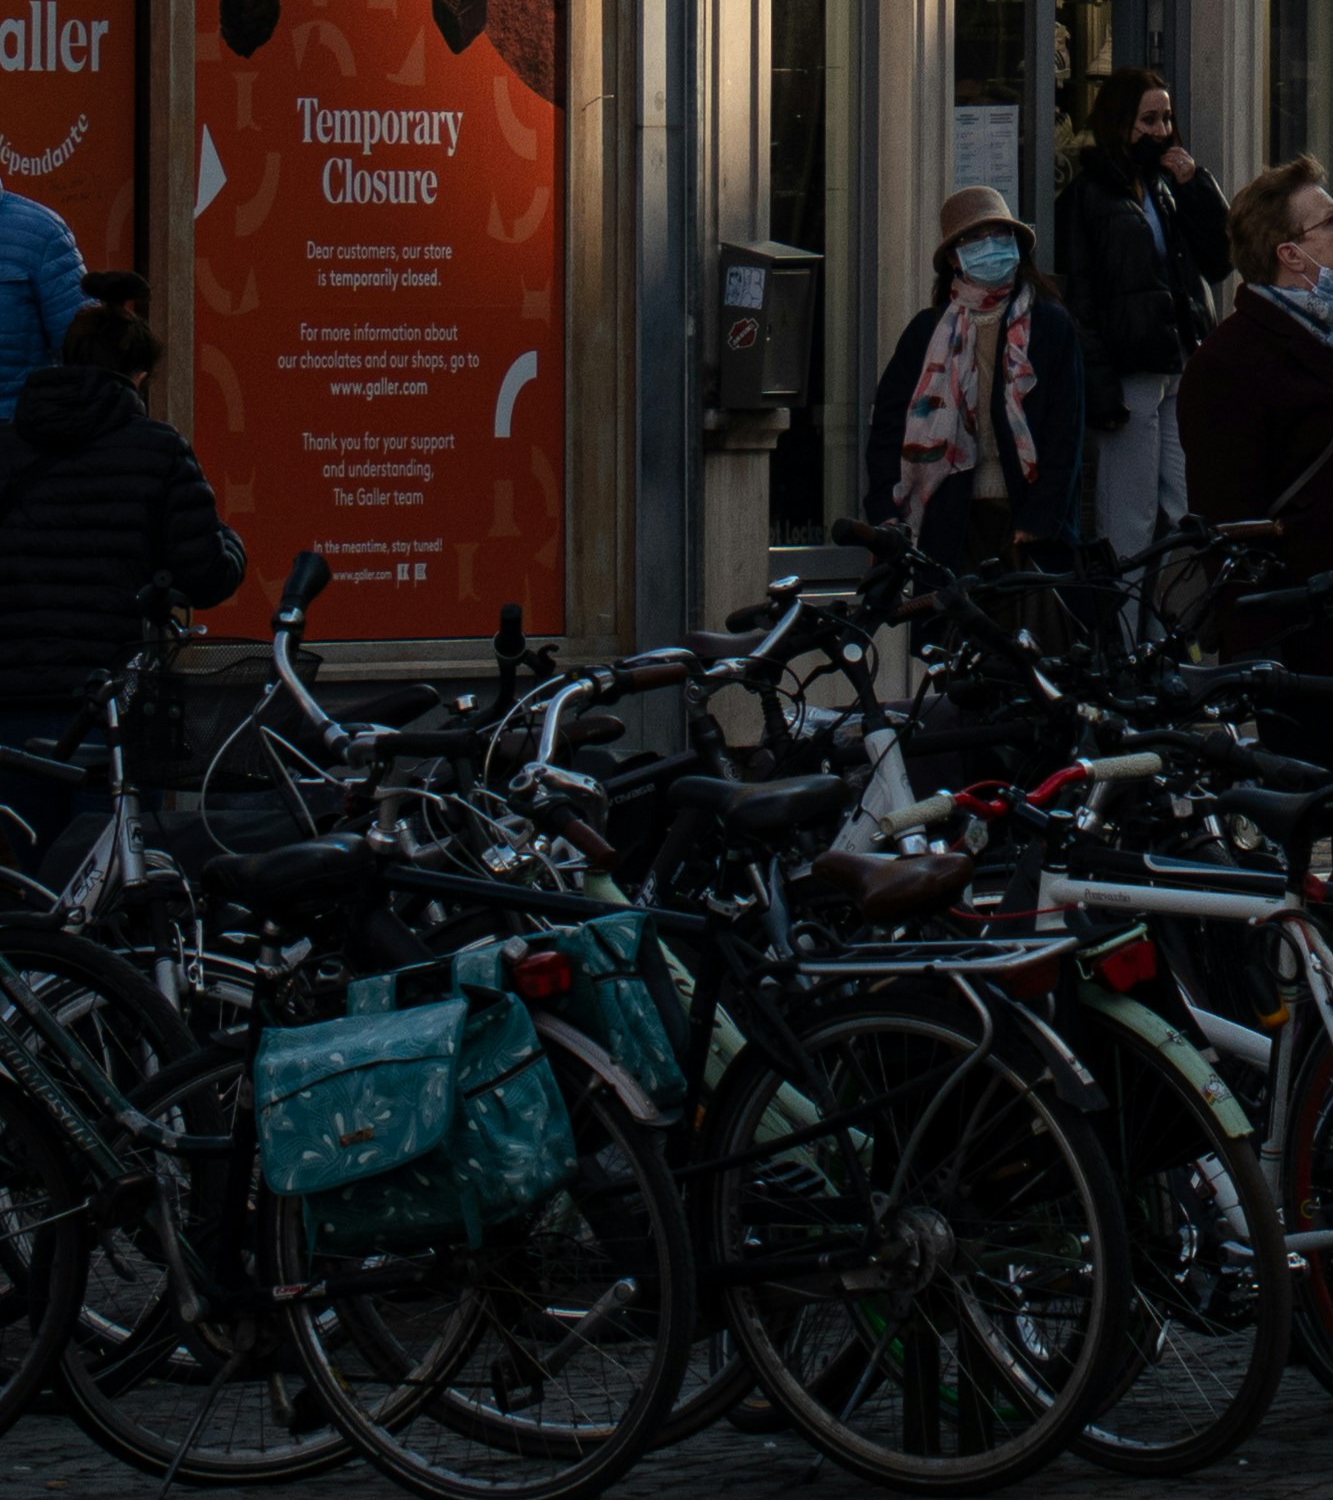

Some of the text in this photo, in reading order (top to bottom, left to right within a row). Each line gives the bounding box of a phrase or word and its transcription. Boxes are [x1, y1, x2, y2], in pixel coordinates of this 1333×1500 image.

[295, 97, 465, 157] Temporary
[321, 156, 439, 204] Closure
[306, 240, 453, 263] Dear customers, our store
[317, 268, 442, 292] is temporarily closed.
[300, 322, 459, 342] For more information about
[278, 350, 480, 374] our chocolates and our shops, go to
[329, 376, 429, 401] www.galler.com
[302, 431, 455, 455] Thank you for your support
[322, 458, 434, 483] and understanding,
[333, 487, 424, 506] The Galler team
[313, 538, 443, 556] In the meantime, stay tuned!
[331, 568, 392, 584] www.galler.com
